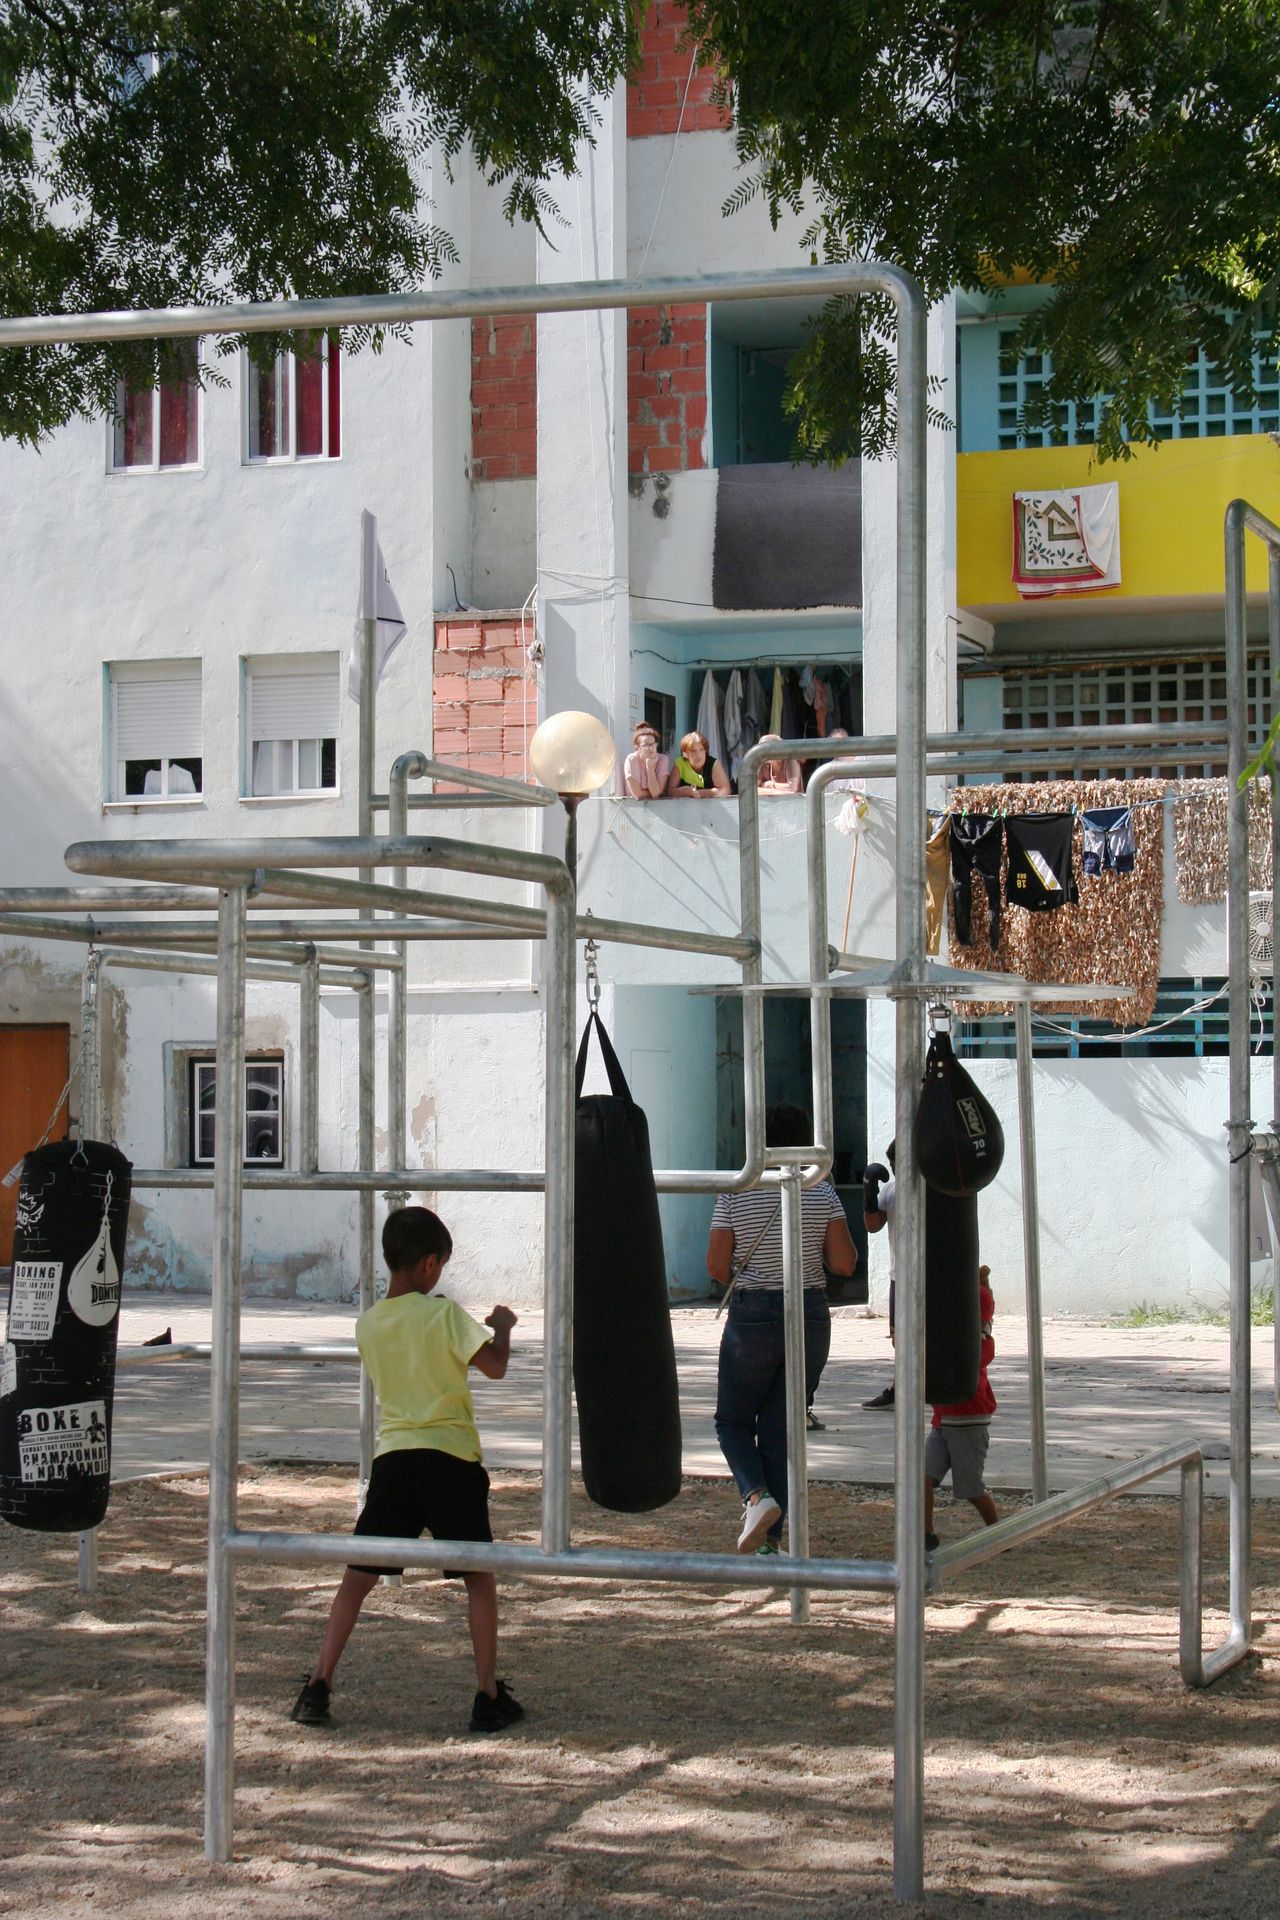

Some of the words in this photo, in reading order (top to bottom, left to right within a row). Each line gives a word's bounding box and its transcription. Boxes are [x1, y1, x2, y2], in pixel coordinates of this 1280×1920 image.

[972, 1138, 985, 1150] 70
[16, 1266, 56, 1279] BOXING
[20, 1409, 81, 1433] BOXE
[22, 1446, 43, 1454] COMBAT
[23, 1447, 107, 1467] CHAMPIONNAT
[38, 1460, 108, 1478] NORMANDIE
